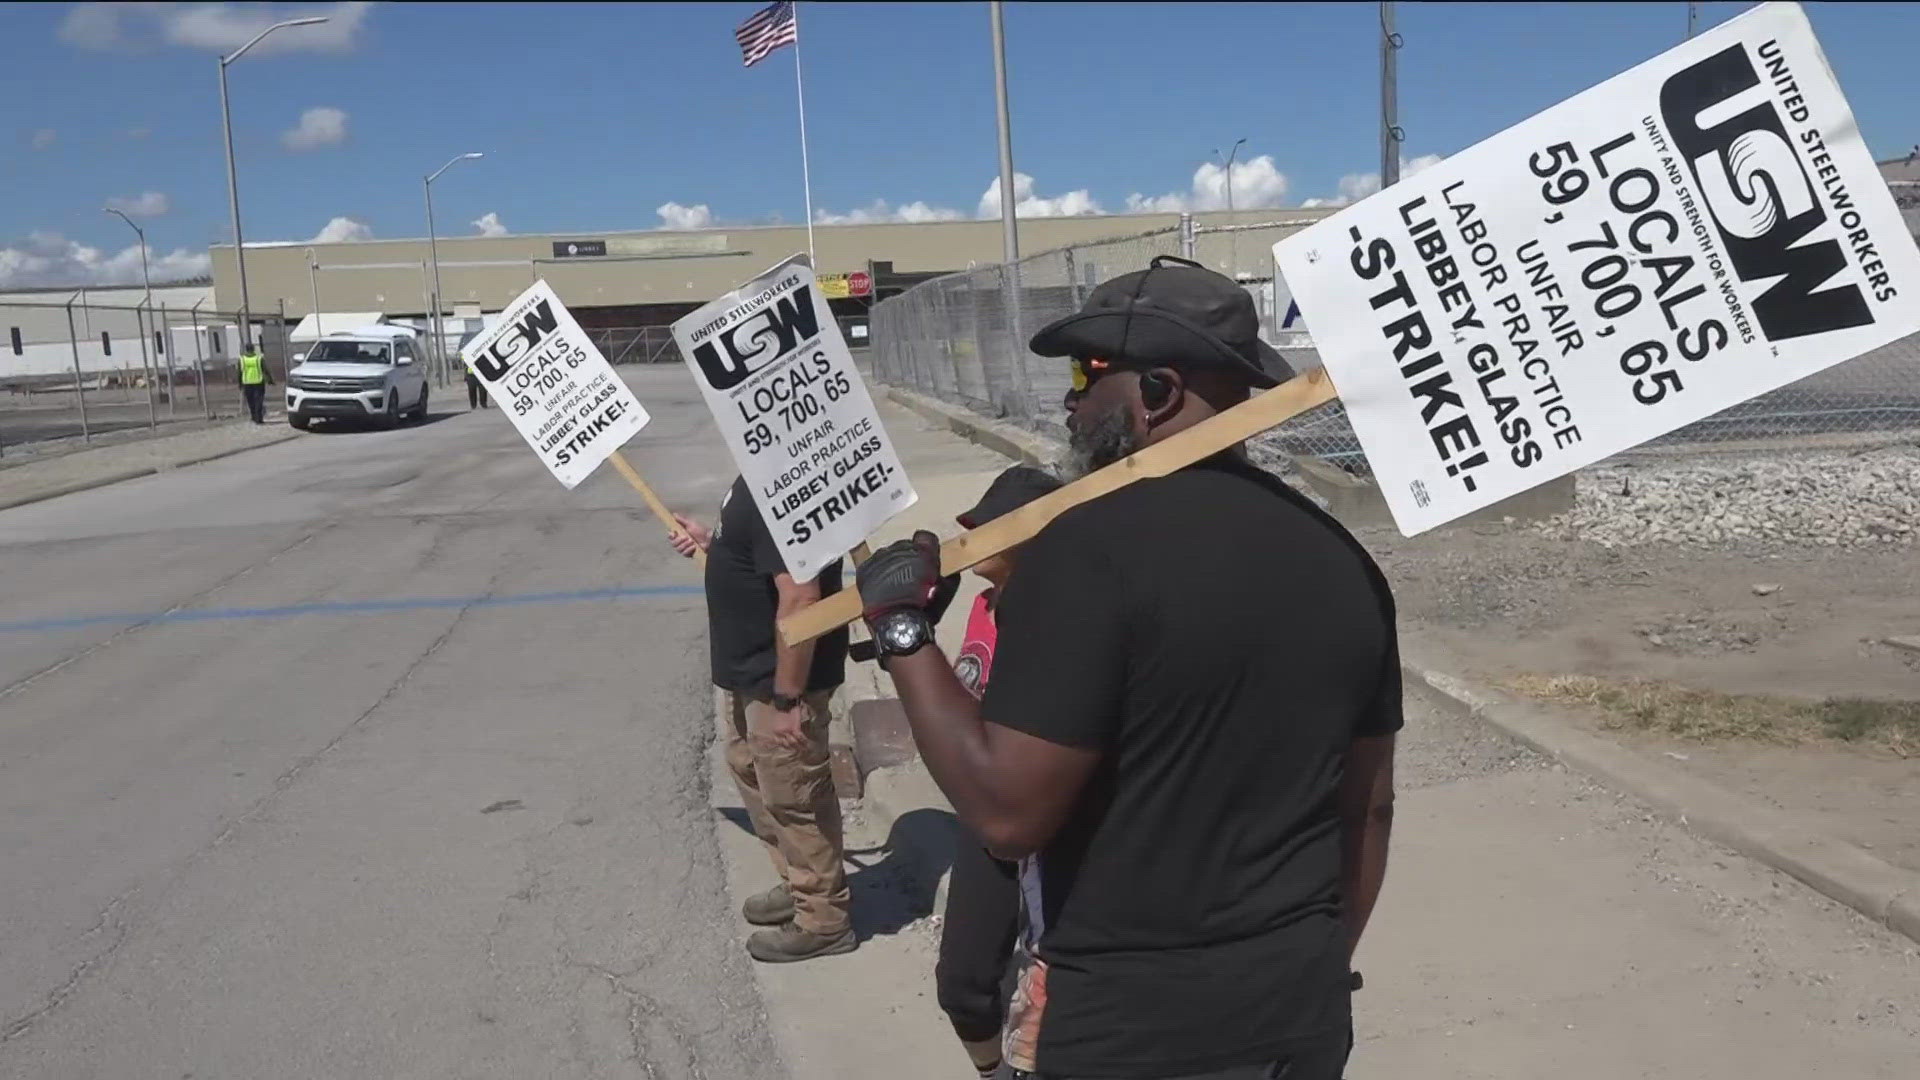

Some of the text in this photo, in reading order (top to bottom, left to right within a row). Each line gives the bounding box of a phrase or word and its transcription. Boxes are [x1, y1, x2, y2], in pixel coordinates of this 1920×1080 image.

[1660, 41, 1875, 342] USW
[1757, 39, 1898, 302] UNITED STEELWORKERS
[1589, 132, 1728, 362] LOCALS
[1642, 115, 1756, 345] UNITY AND STRENGTH FOR WORKERS
[690, 274, 800, 343] UNITED STEELWORKERS
[850, 279, 870, 289] STOP
[1441, 180, 1582, 450] LABOR PRACTICE
[1516, 239, 1585, 358] UNFAIR
[1529, 141, 1684, 406] 59, 700, 65
[474, 298, 558, 382] USW
[506, 337, 570, 398] LOCALS
[693, 284, 819, 390] USW
[1399, 196, 1543, 469] LIBBEY GLASS
[513, 394, 539, 416] 59,
[533, 367, 569, 396] 700,
[565, 346, 587, 369] 65
[532, 372, 608, 441] LABOR PRACTICE
[540, 383, 617, 453] LIBBEY GLASS
[544, 380, 578, 412] UNFAIR
[738, 351, 831, 424] LOCALS
[743, 371, 850, 455] 59, 700, 65
[764, 417, 873, 498] LABOR PRACTICE
[771, 435, 882, 521] LIBBEY GLASS
[787, 419, 836, 458] UNFAIR
